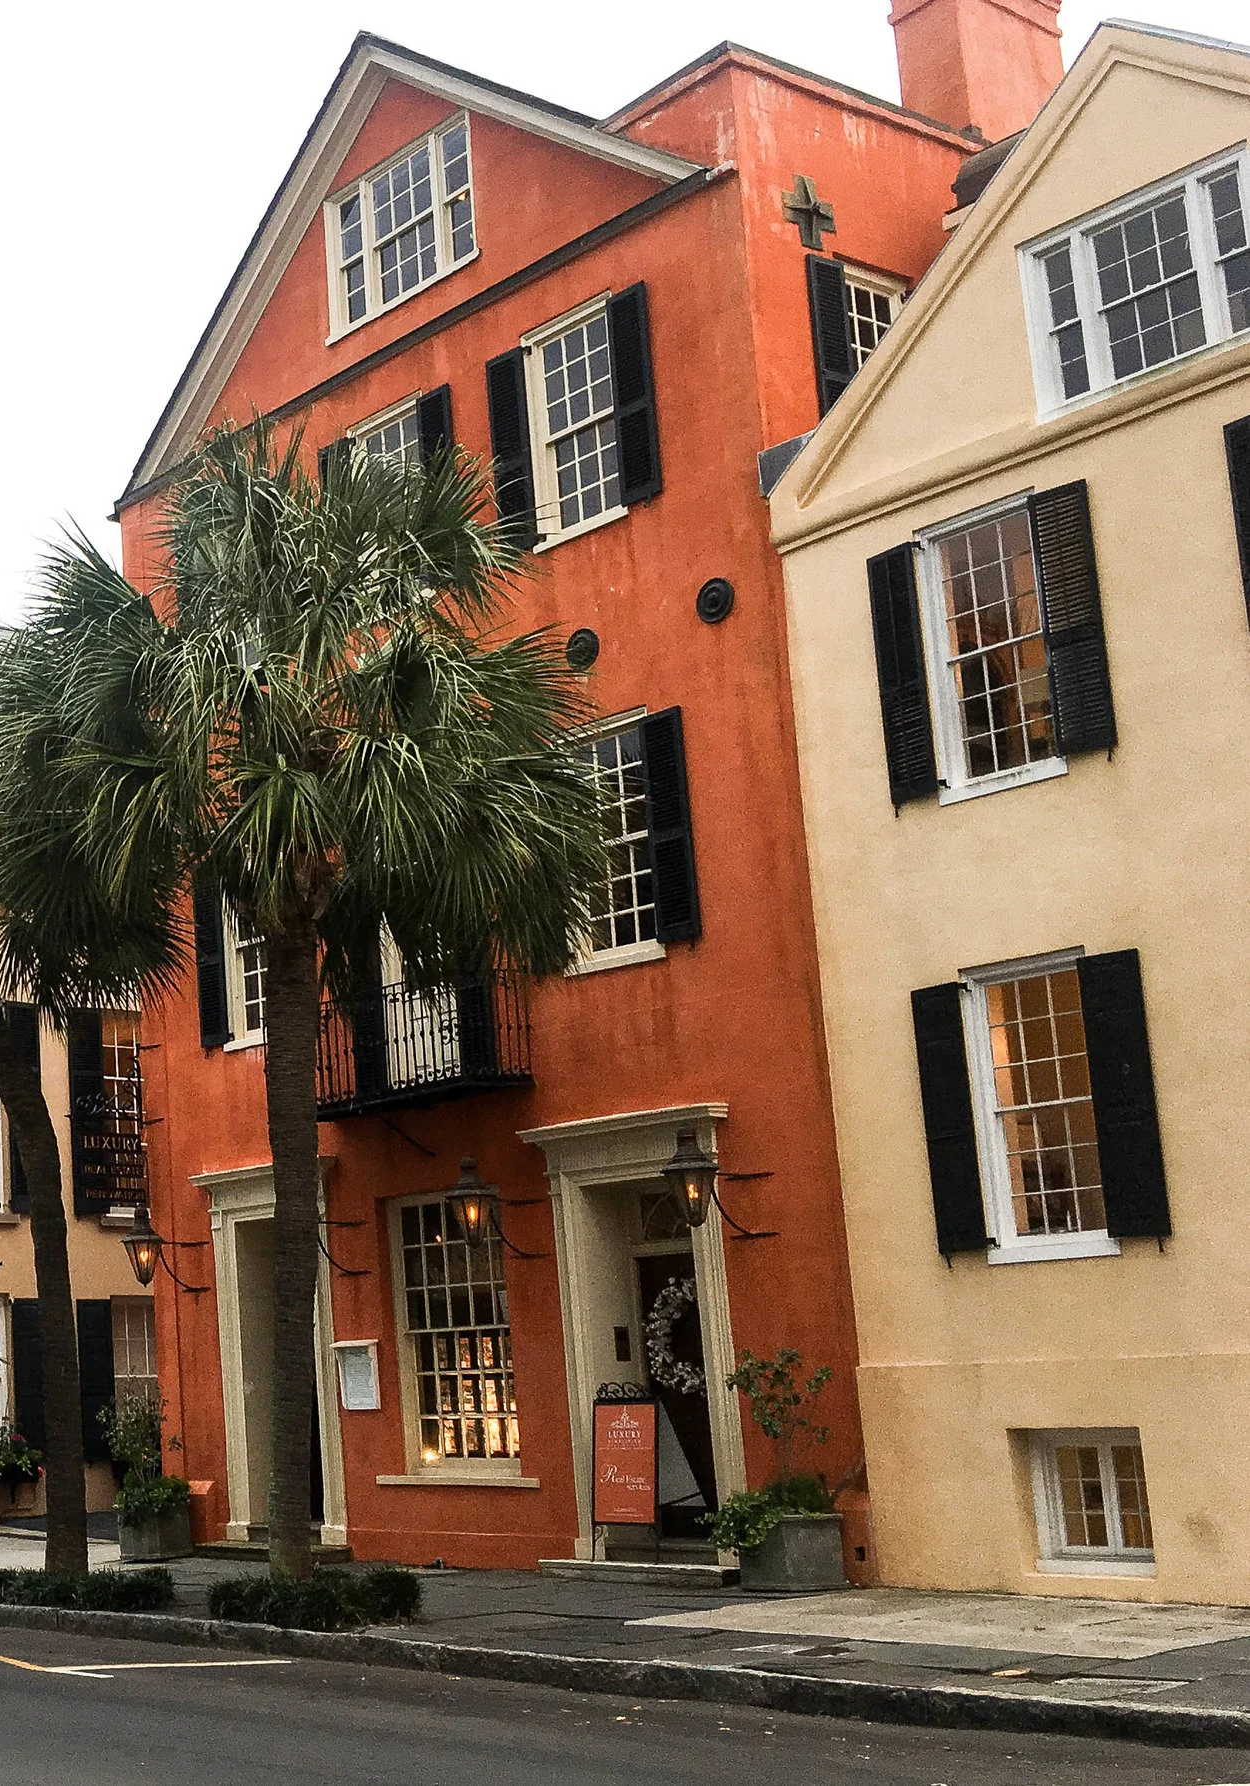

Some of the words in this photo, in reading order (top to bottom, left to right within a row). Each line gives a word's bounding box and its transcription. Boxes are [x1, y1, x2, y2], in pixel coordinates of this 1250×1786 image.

[84, 1135, 138, 1150] LUXURY
[84, 1164, 107, 1175] REAL
[608, 1430, 642, 1439] LUXURY
[600, 1463, 625, 1483] Real
